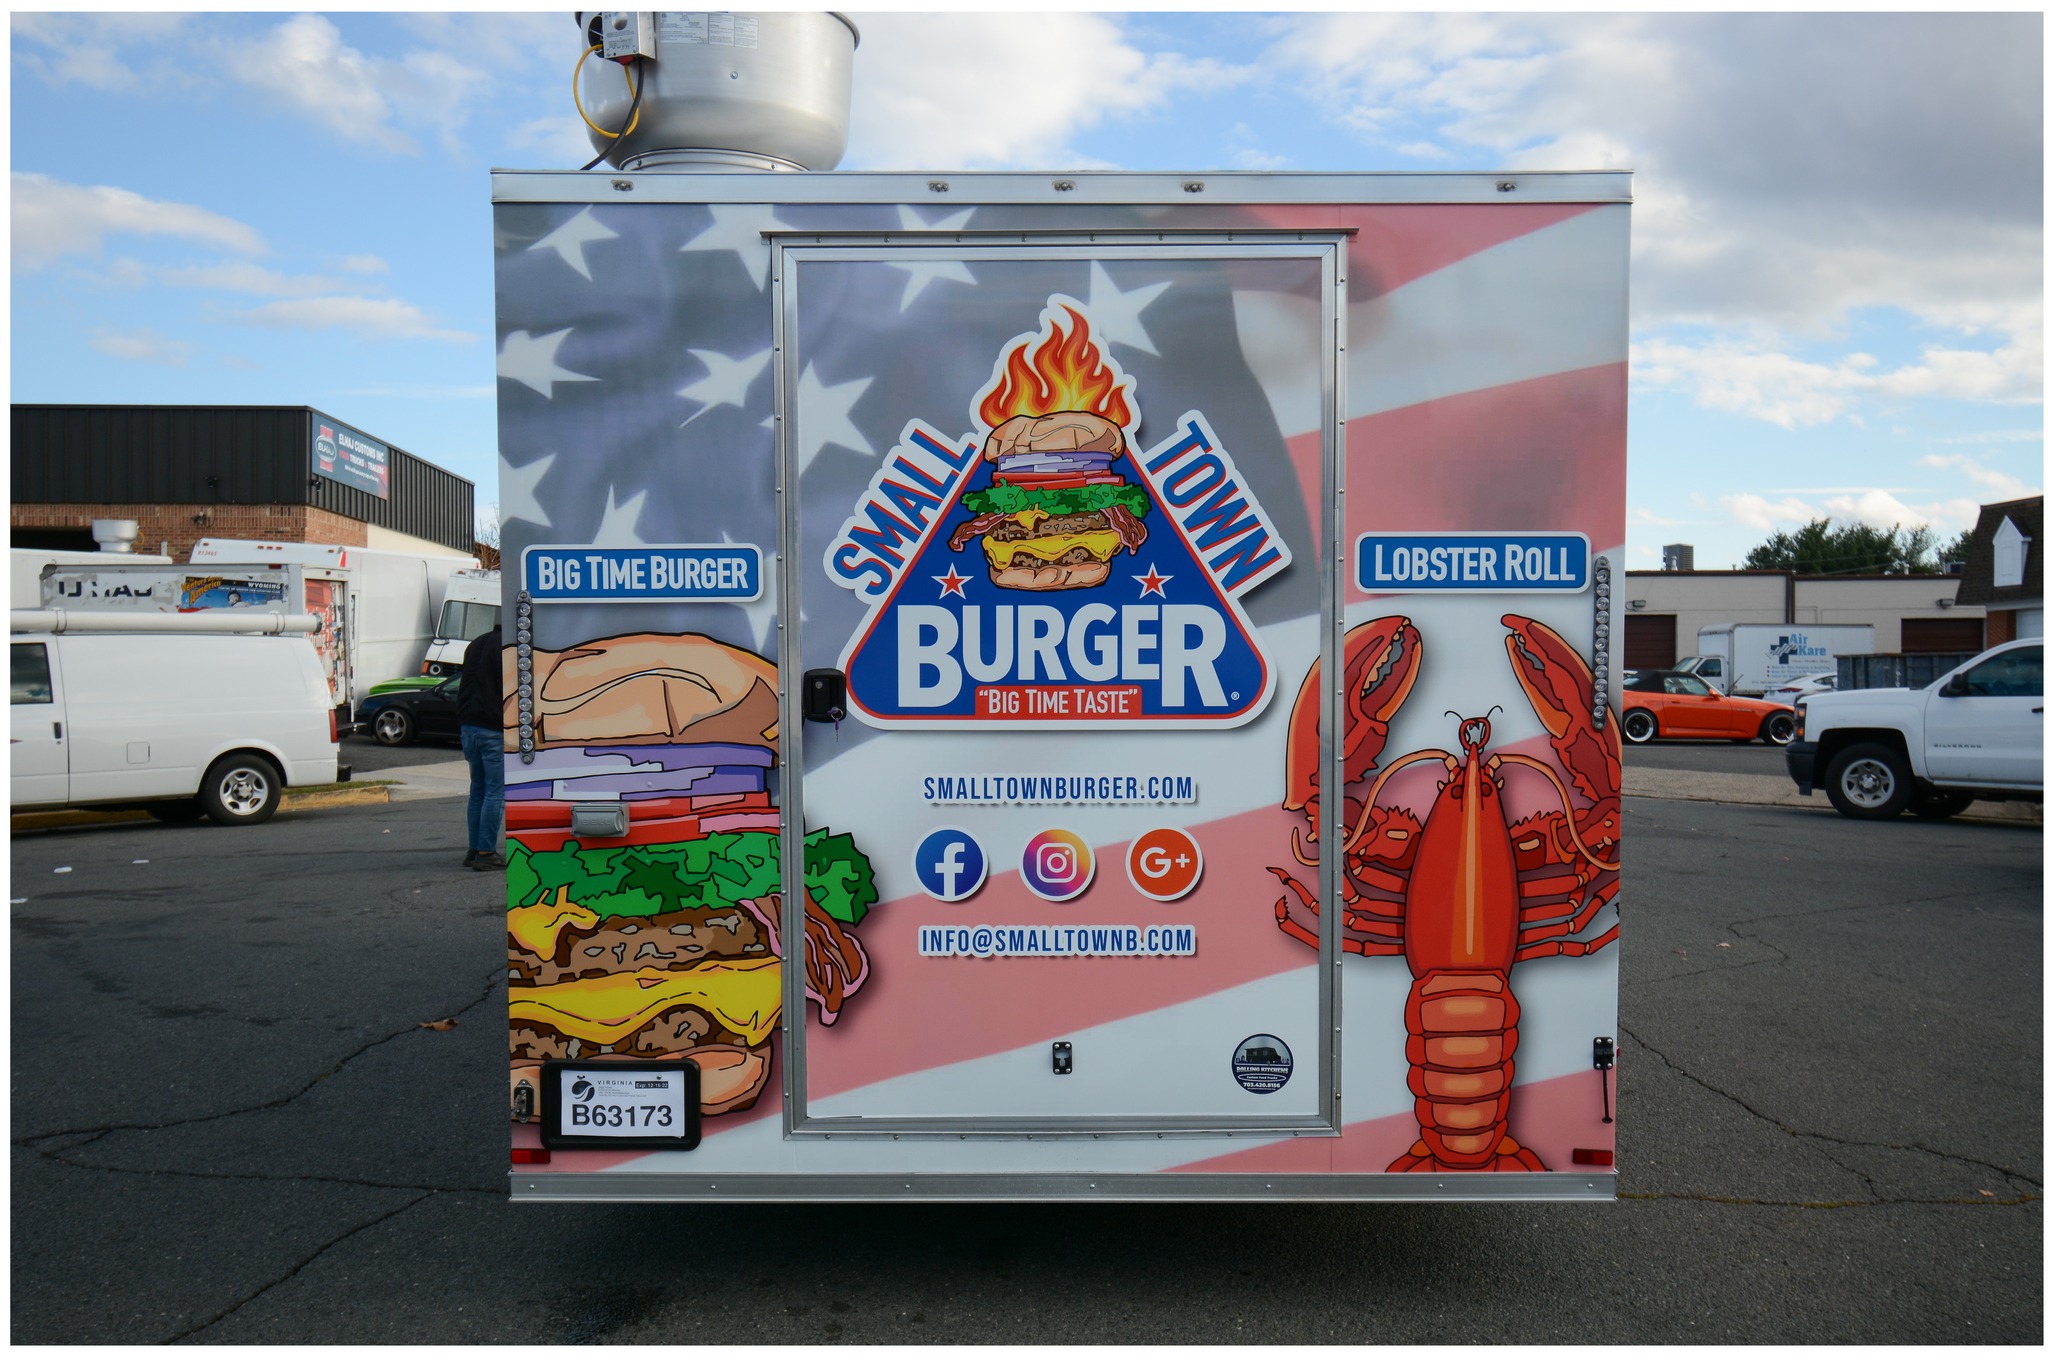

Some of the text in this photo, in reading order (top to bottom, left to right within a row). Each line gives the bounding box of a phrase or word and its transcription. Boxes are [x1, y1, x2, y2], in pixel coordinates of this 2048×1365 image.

[833, 428, 977, 596] SMALL
[1144, 420, 1283, 593] TOWN
[538, 555, 749, 590] BIG TIME BURGER
[1375, 544, 1576, 582] LOBSTER ROLL
[248, 582, 281, 590] WYOMING
[1790, 634, 1808, 645] Air
[1799, 645, 1827, 657] Kare
[897, 603, 1229, 707] BURGER
[1025, 689, 1069, 714] TIME
[924, 776, 1192, 800] SMALLTOWNBURGER.COM
[922, 929, 1192, 953] INFO@SMALLTOWNB.COM
[572, 1104, 673, 1127] B63173
